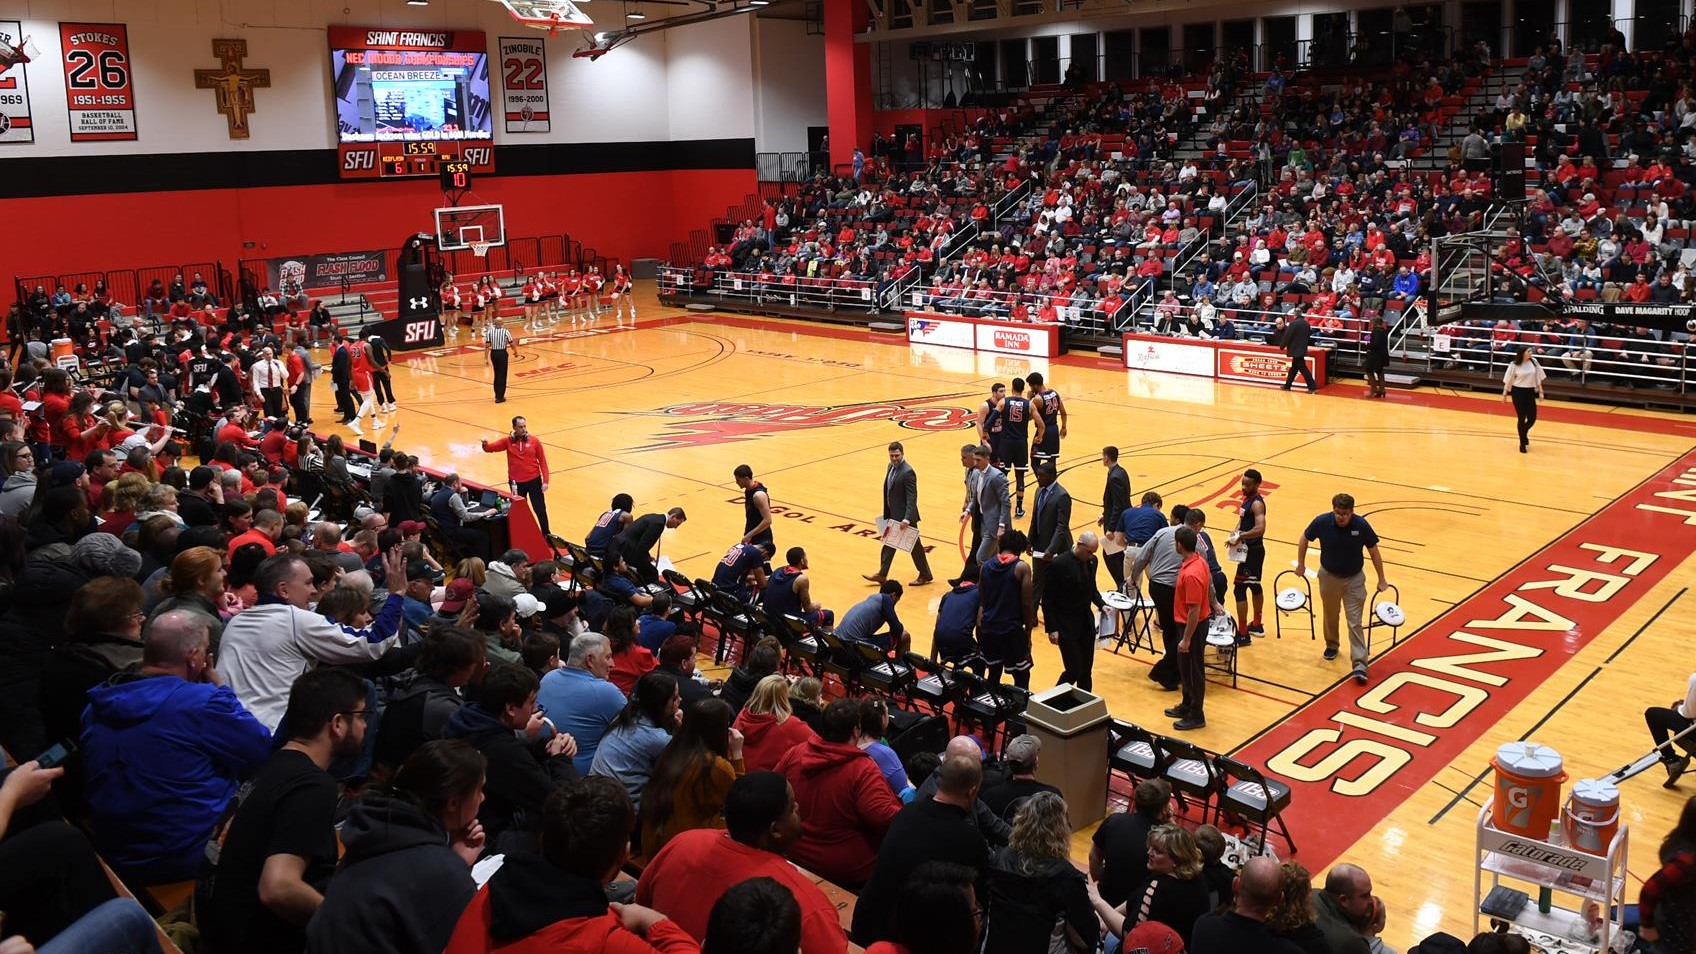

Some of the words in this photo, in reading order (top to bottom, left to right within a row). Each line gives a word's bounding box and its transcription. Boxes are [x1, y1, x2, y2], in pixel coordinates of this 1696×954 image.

[70, 32, 118, 46] STOKES
[366, 32, 398, 46] SAINT
[400, 32, 446, 47] FRANCIS
[346, 52, 364, 64] NEC
[503, 46, 542, 55] ZINOBILE
[66, 50, 128, 89] 26
[376, 72, 405, 80] OCEAN
[408, 70, 440, 80] BREEZE
[504, 58, 544, 90] 22
[73, 95, 126, 105] 1951-1955
[408, 143, 434, 154] 15:59
[344, 151, 374, 170] SFU
[464, 148, 490, 165] SFU
[448, 164, 468, 172] 15:59
[454, 172, 466, 187] 10
[316, 262, 348, 276] FLASH
[348, 260, 380, 273] FLOOD
[1615, 306, 1634, 315] DAVE
[1635, 307, 1672, 316] MAGARITY
[1674, 308, 1690, 316] HOOP
[405, 320, 436, 342] SFU
[995, 332, 1029, 342] RAMADA
[1004, 340, 1020, 348] INN
[193, 364, 207, 372] SFU
[1242, 362, 1287, 371] SHEETZ
[1009, 406, 1023, 422] 15
[727, 496, 816, 524] DGOL
[1264, 542, 1661, 796] FRANCIS
[1509, 787, 1528, 808] G
[1500, 840, 1588, 871] Gatorade
